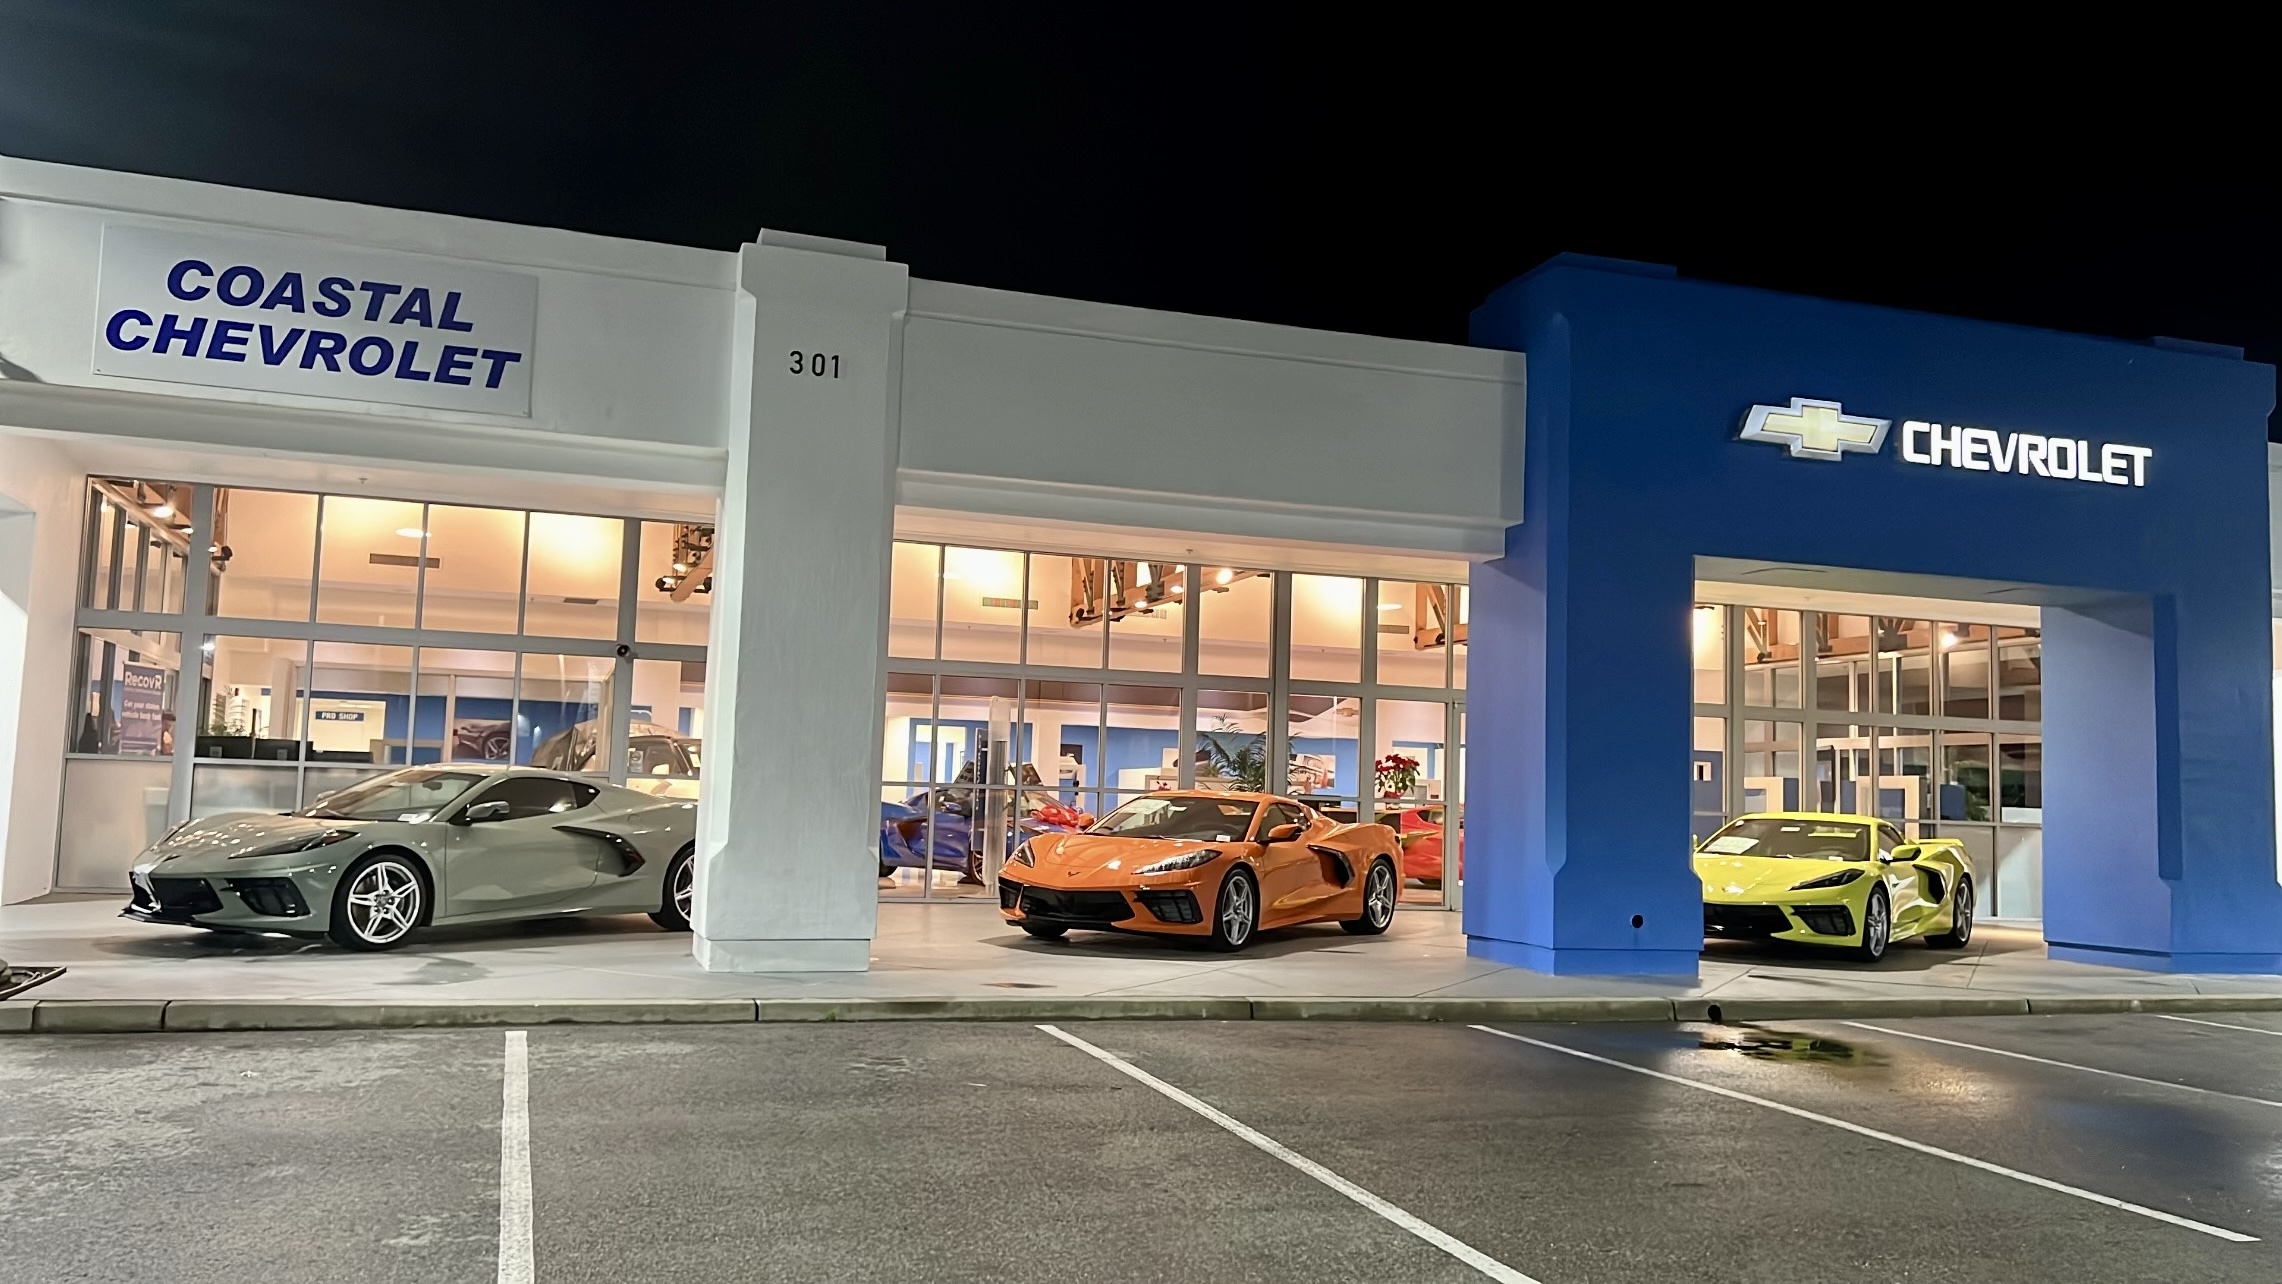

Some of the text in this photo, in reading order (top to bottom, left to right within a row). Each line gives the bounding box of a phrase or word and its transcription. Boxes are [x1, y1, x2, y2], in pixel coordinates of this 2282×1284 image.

[166, 259, 474, 333] COASTAL
[105, 309, 522, 389] CHEVROLET
[789, 350, 839, 379] 301
[1902, 420, 2153, 487] CHEVROLET
[124, 671, 162, 690] RecovR
[321, 711, 359, 721] PRO SHOP
